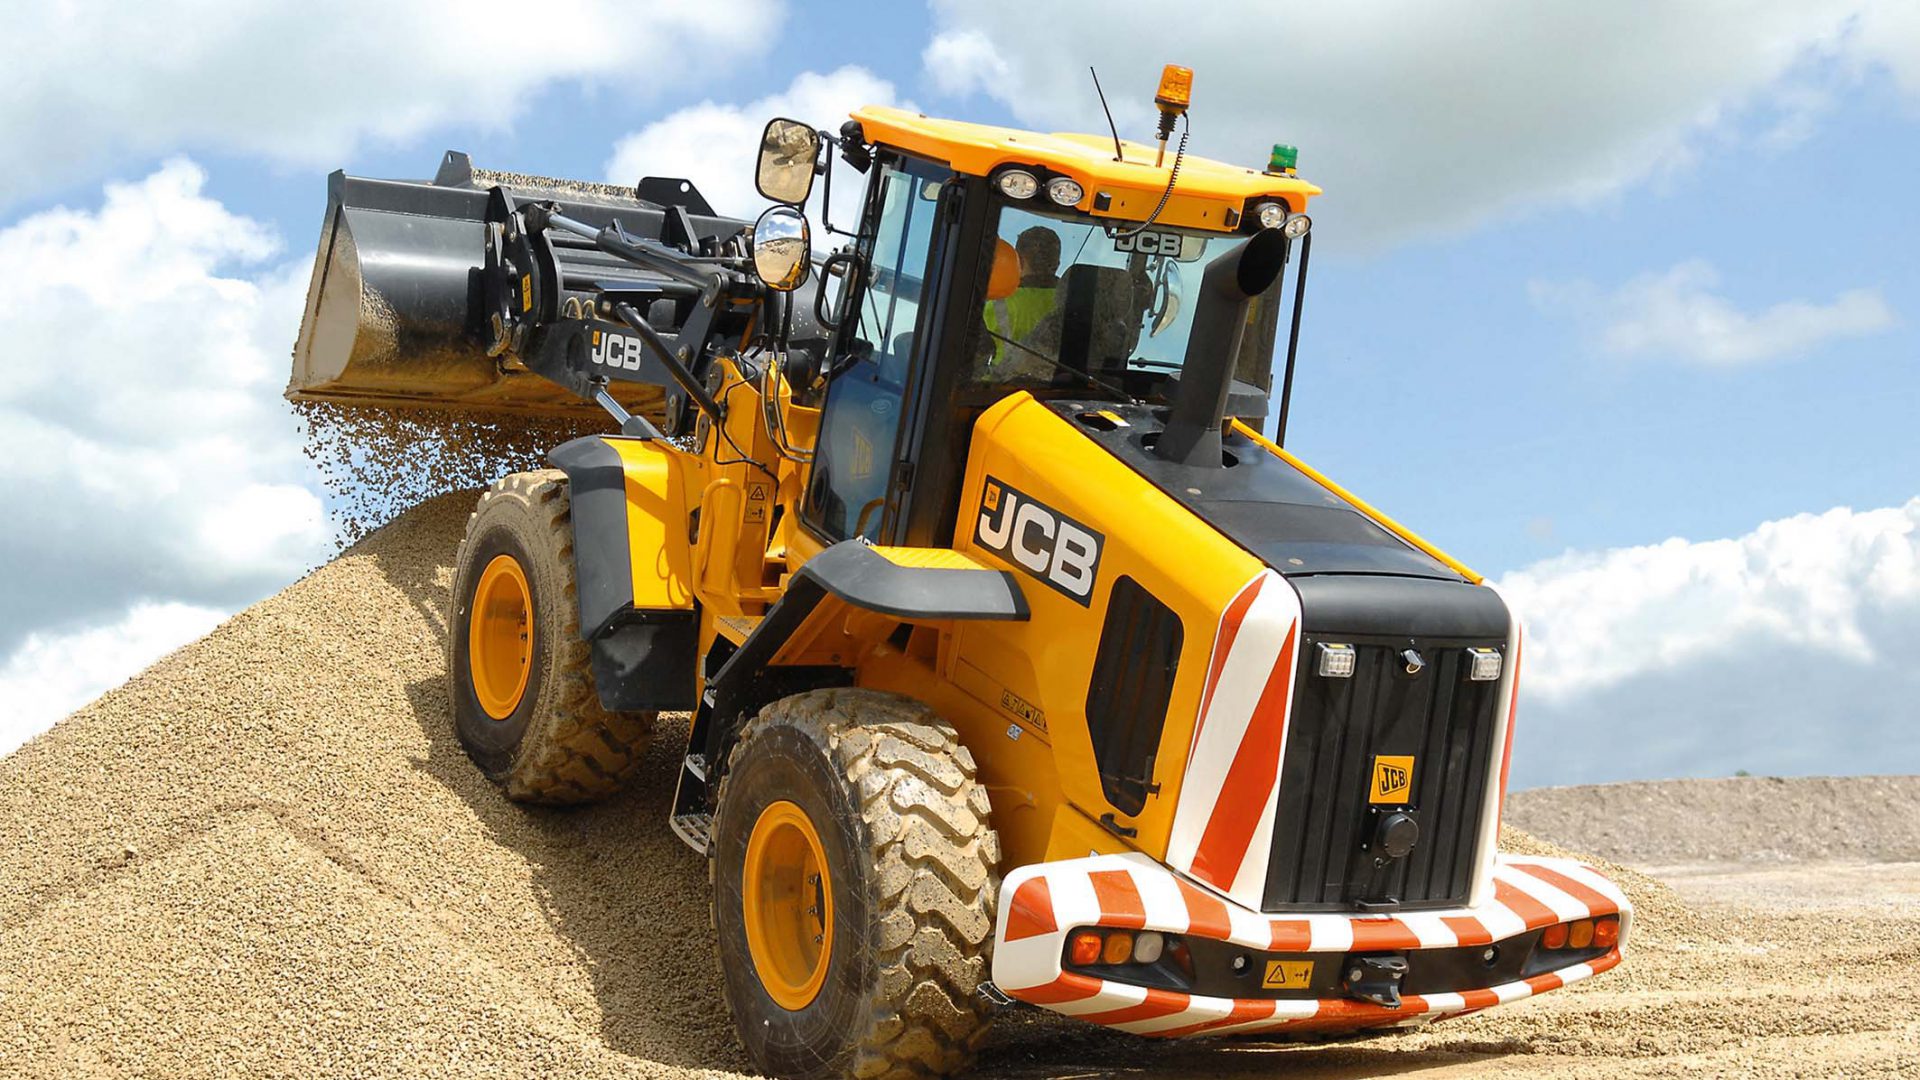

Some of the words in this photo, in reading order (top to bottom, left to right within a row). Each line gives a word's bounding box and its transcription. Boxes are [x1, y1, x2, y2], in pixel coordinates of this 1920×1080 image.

[1116, 231, 1181, 256] JCB
[592, 332, 642, 371] JCB
[979, 493, 1098, 597] JCB
[1381, 767, 1406, 792] JCB
